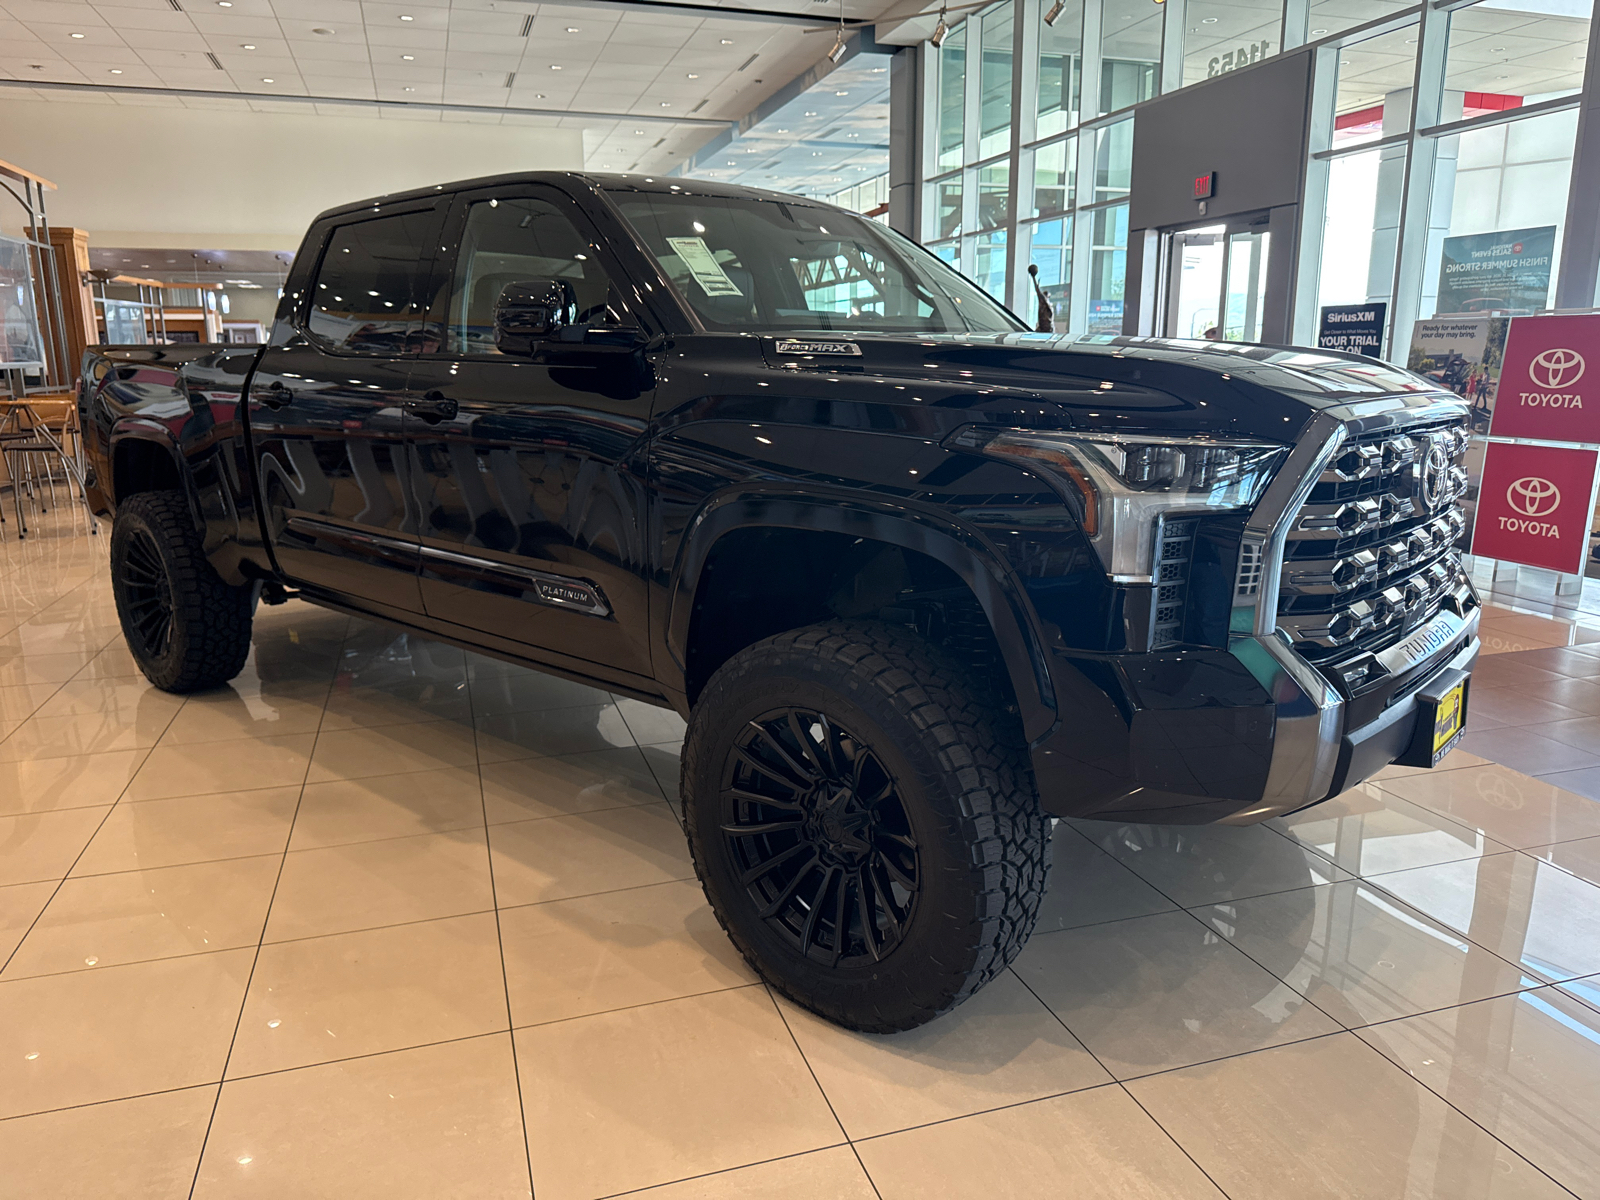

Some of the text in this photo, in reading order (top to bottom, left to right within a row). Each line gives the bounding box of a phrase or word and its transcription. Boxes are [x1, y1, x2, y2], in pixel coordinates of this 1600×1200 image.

[1194, 175, 1210, 196] EXIT
[1327, 311, 1375, 323] SiriusXM
[1422, 324, 1440, 332] Ready
[1450, 323, 1478, 331] whatever
[1320, 335, 1379, 347] YOUR TRIAL
[1434, 331, 1445, 339] day
[1459, 331, 1476, 339] bring.
[1346, 346, 1362, 355] ON
[1519, 392, 1583, 409] TOYOTA
[1498, 516, 1560, 539] TOYOTA
[542, 585, 588, 602] PLATINUM
[1399, 620, 1455, 661] TUNDRA
